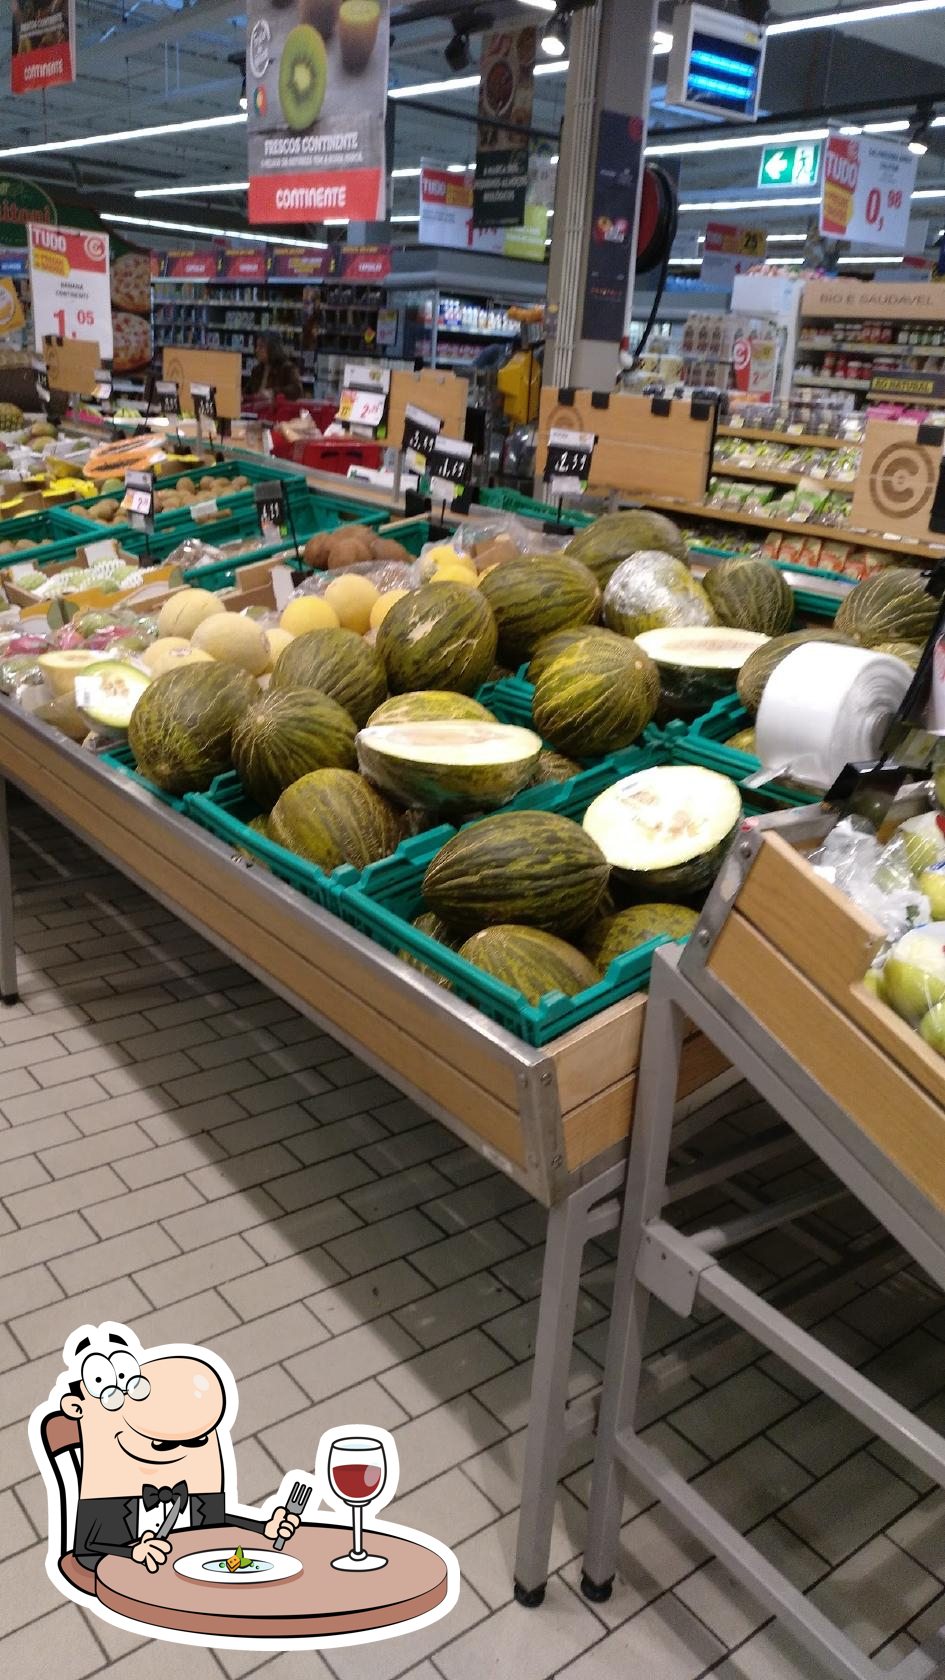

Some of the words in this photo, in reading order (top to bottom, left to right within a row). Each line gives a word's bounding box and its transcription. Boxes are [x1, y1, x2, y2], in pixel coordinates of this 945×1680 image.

[825, 153, 858, 190] TUDO
[275, 184, 347, 210] CONTINENTE
[32, 229, 66, 253] TUDO
[820, 293, 843, 305] BIO
